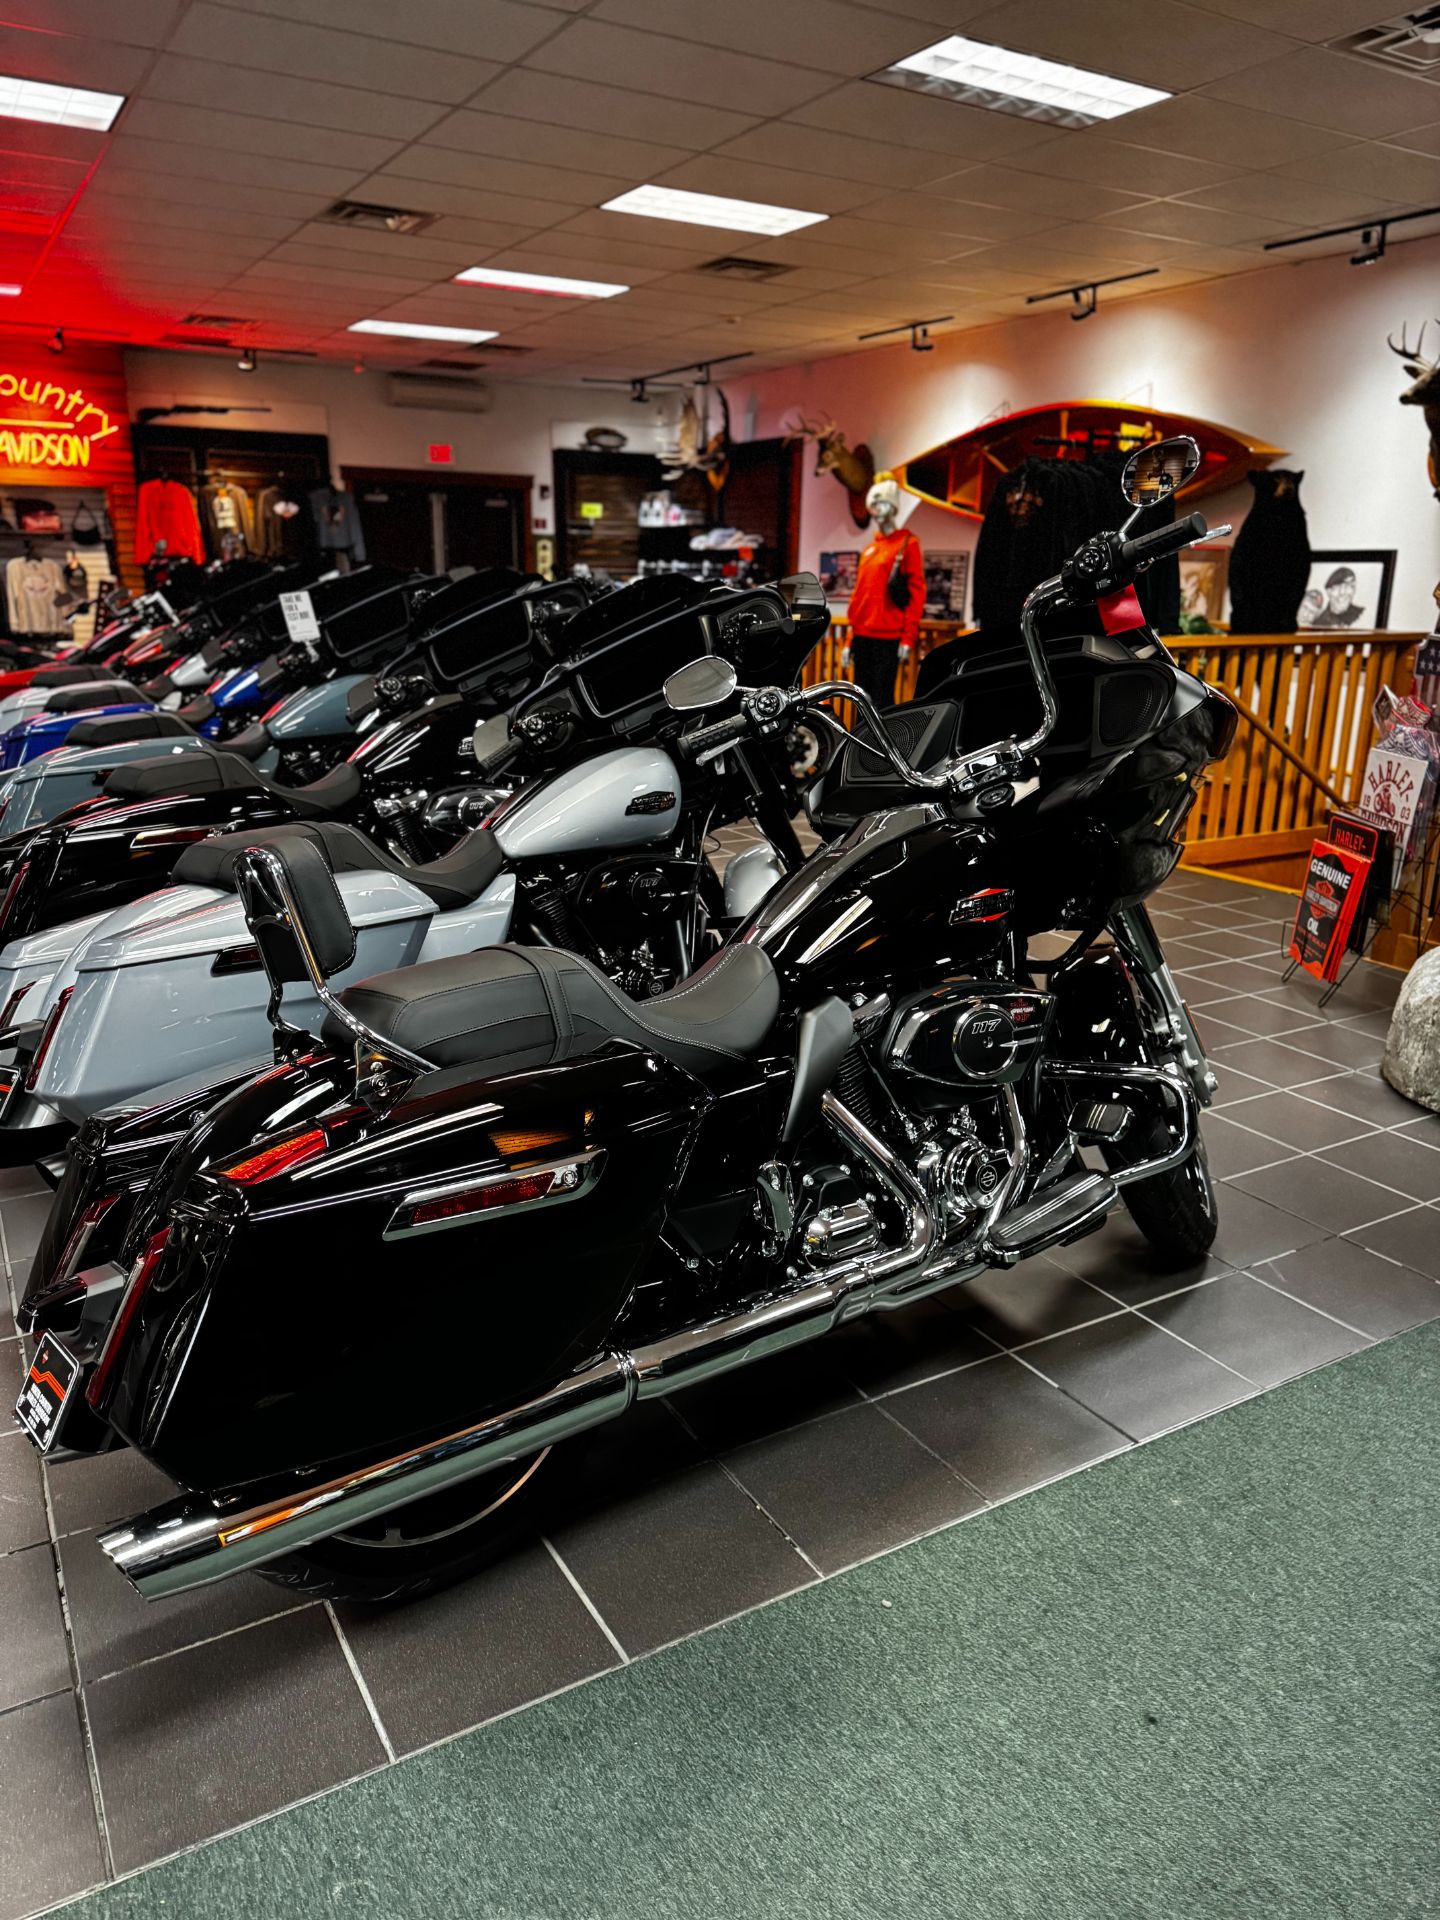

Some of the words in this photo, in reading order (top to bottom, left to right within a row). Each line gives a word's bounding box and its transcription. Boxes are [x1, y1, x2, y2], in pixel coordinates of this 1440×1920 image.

[0, 373, 119, 441] ountry
[0, 430, 90, 467] AVIDSON
[1368, 760, 1414, 802] HARLEY-
[1363, 794, 1372, 808] 19
[1400, 806, 1411, 820] 03
[1334, 828, 1367, 850] HARLEY-
[1310, 858, 1351, 890] GENUINE
[1307, 918, 1319, 936] OIL
[971, 1018, 1002, 1035] 117
